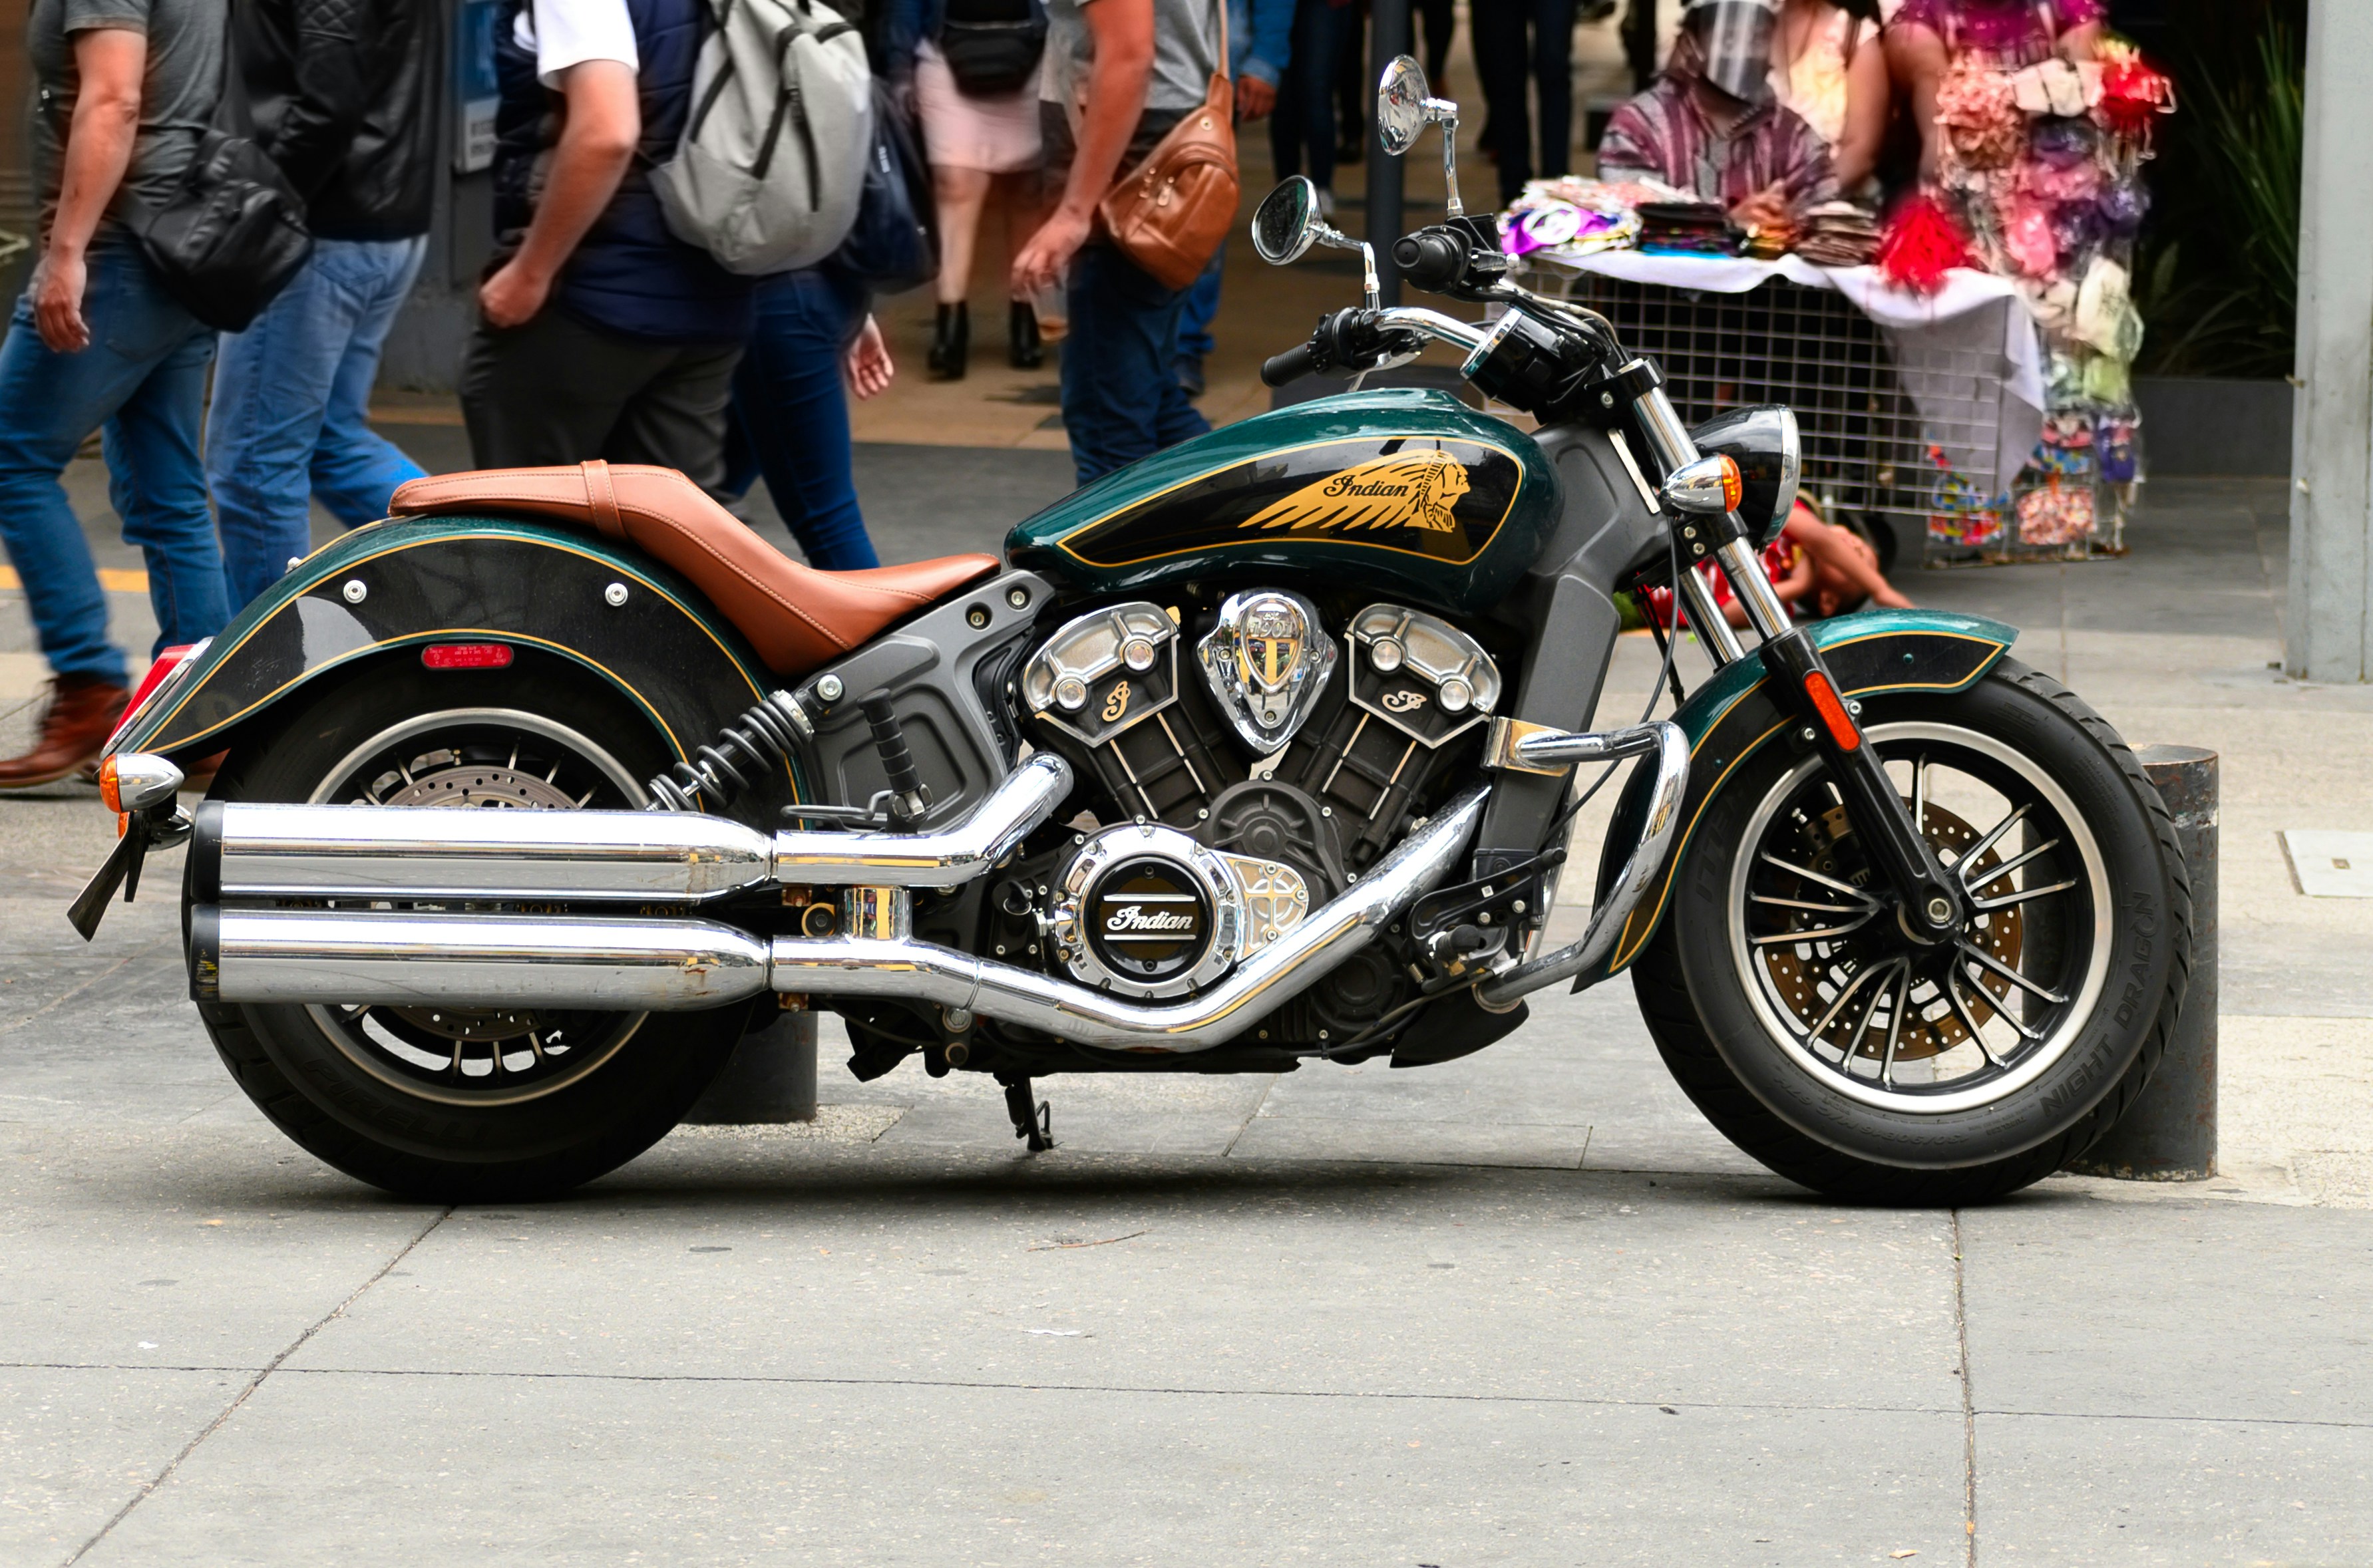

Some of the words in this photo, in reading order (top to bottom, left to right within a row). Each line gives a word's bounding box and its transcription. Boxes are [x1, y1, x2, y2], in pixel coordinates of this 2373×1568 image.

[1323, 474, 1409, 498] Indian
[1250, 621, 1293, 639] 1901
[1106, 905, 1194, 931] Indian
[2039, 1032, 2115, 1117] NIGHT
[2113, 890, 2157, 1031] DRAGON
